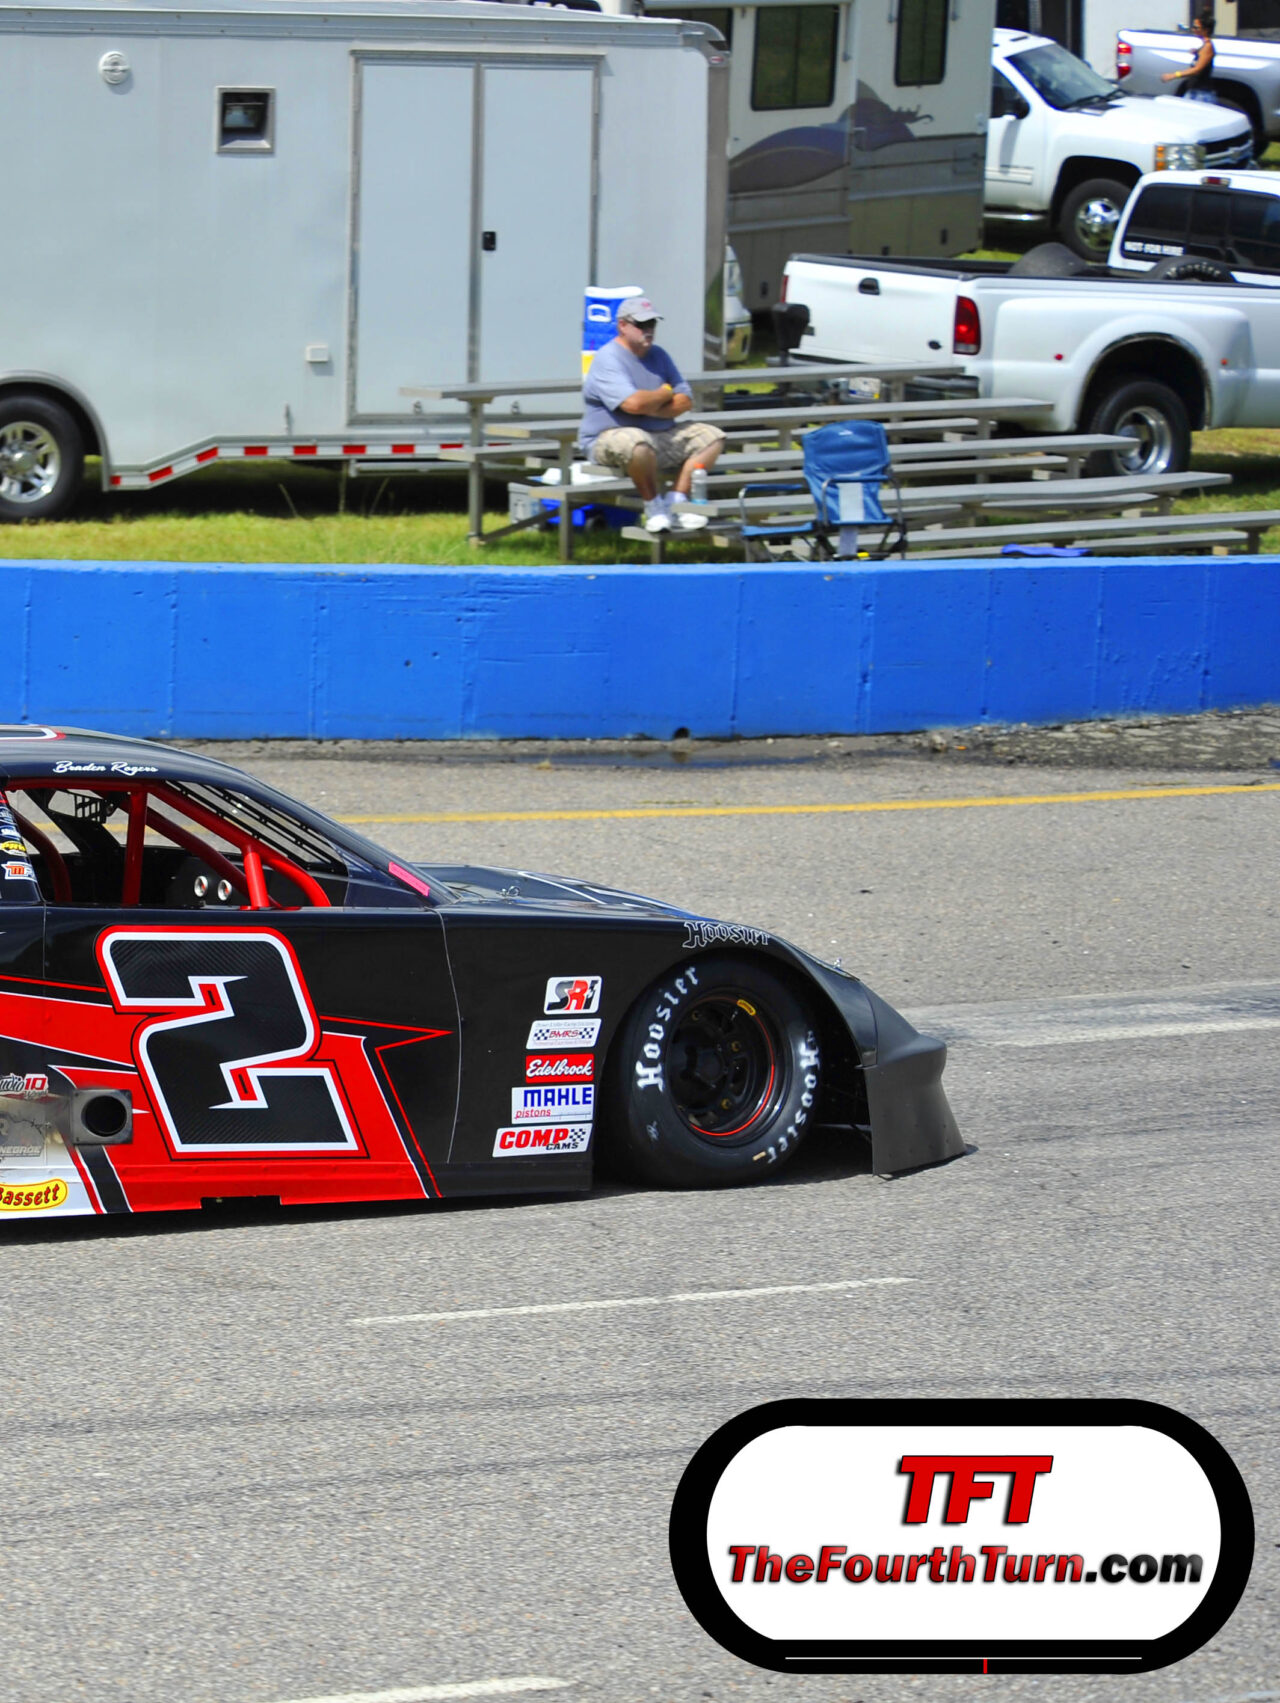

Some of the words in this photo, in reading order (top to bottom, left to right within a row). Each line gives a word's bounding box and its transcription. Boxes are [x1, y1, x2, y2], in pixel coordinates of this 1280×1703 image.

[52, 760, 107, 774] Braden
[110, 761, 159, 776] Rogers
[681, 920, 771, 949] Hoosier
[634, 966, 699, 1093] Hoosier
[95, 925, 368, 1159] 2
[526, 1058, 593, 1078] Edelbrock
[24, 1077, 48, 1092] 10
[523, 1086, 593, 1108] MAHLE
[767, 1040, 820, 1164] Hoosier
[514, 1107, 552, 1120] pistons
[499, 1127, 569, 1150] COMP
[545, 1141, 580, 1151] CAMS
